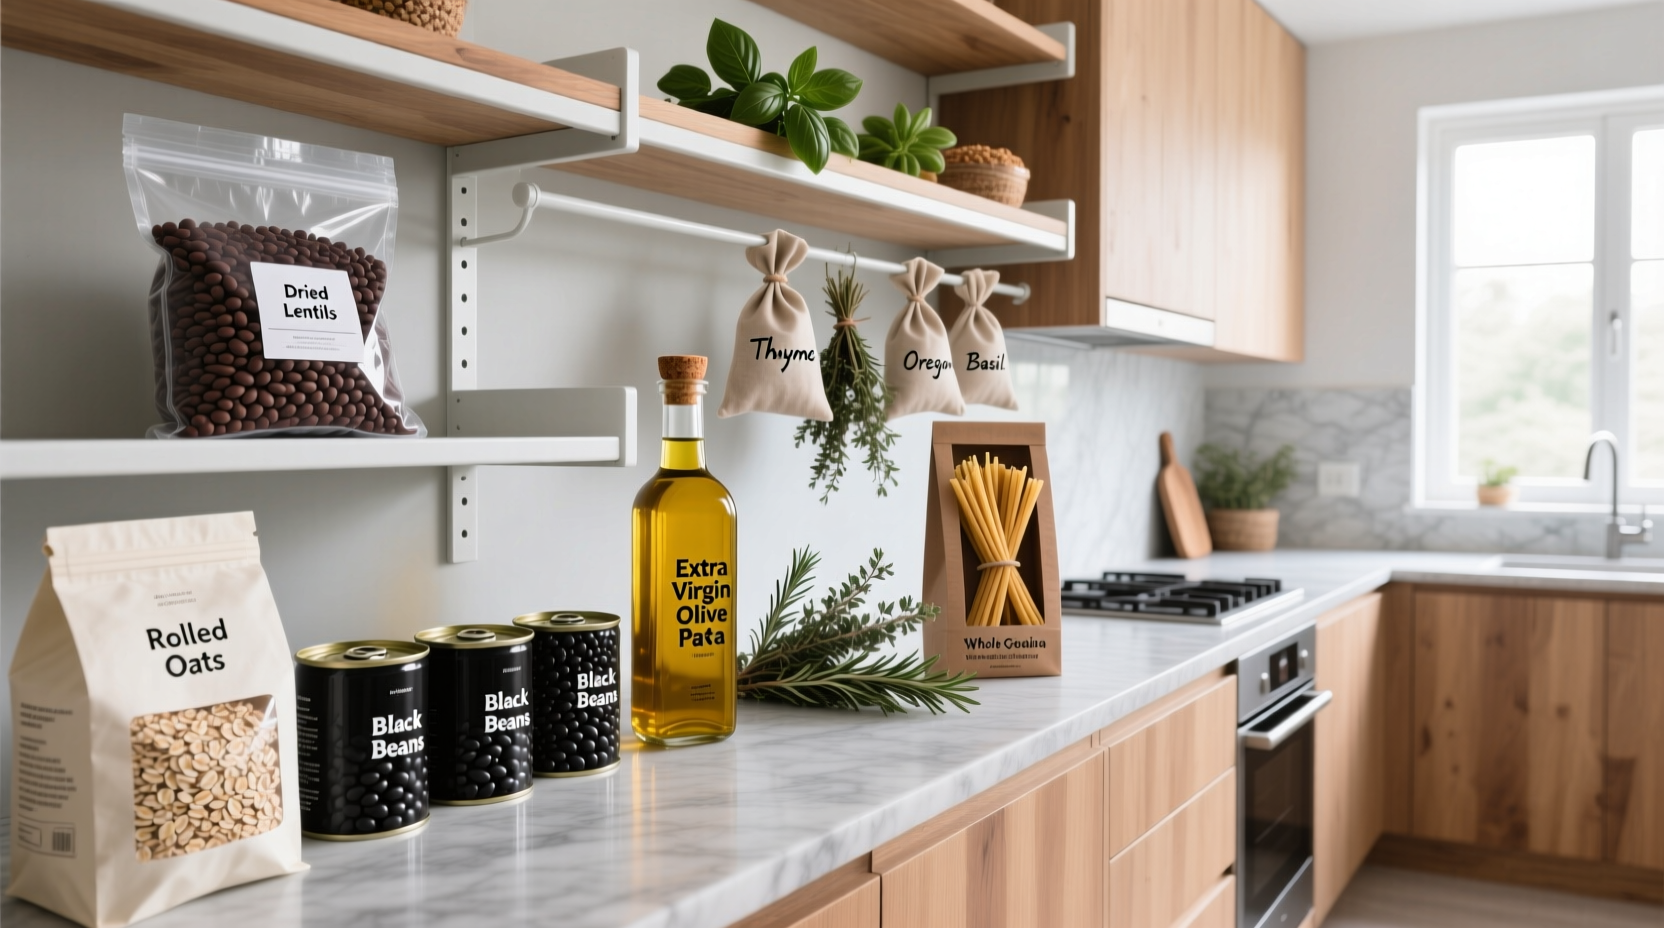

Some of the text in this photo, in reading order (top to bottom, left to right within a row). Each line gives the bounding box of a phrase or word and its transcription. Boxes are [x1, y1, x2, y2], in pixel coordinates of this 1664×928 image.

[284, 284, 329, 300] Dried
[283, 303, 337, 320] Lentils
[966, 352, 1005, 371] Basil
[676, 559, 728, 578] Extra
[671, 580, 731, 604] Virgin
[676, 605, 728, 625] Olive
[146, 617, 228, 650] Rolled
[679, 628, 725, 647] Pata
[165, 651, 226, 678] Oats
[577, 667, 617, 690] Black
[485, 688, 529, 712] Black
[372, 709, 422, 736] Black
[484, 712, 531, 733] Beans
[371, 736, 425, 760] Beans
